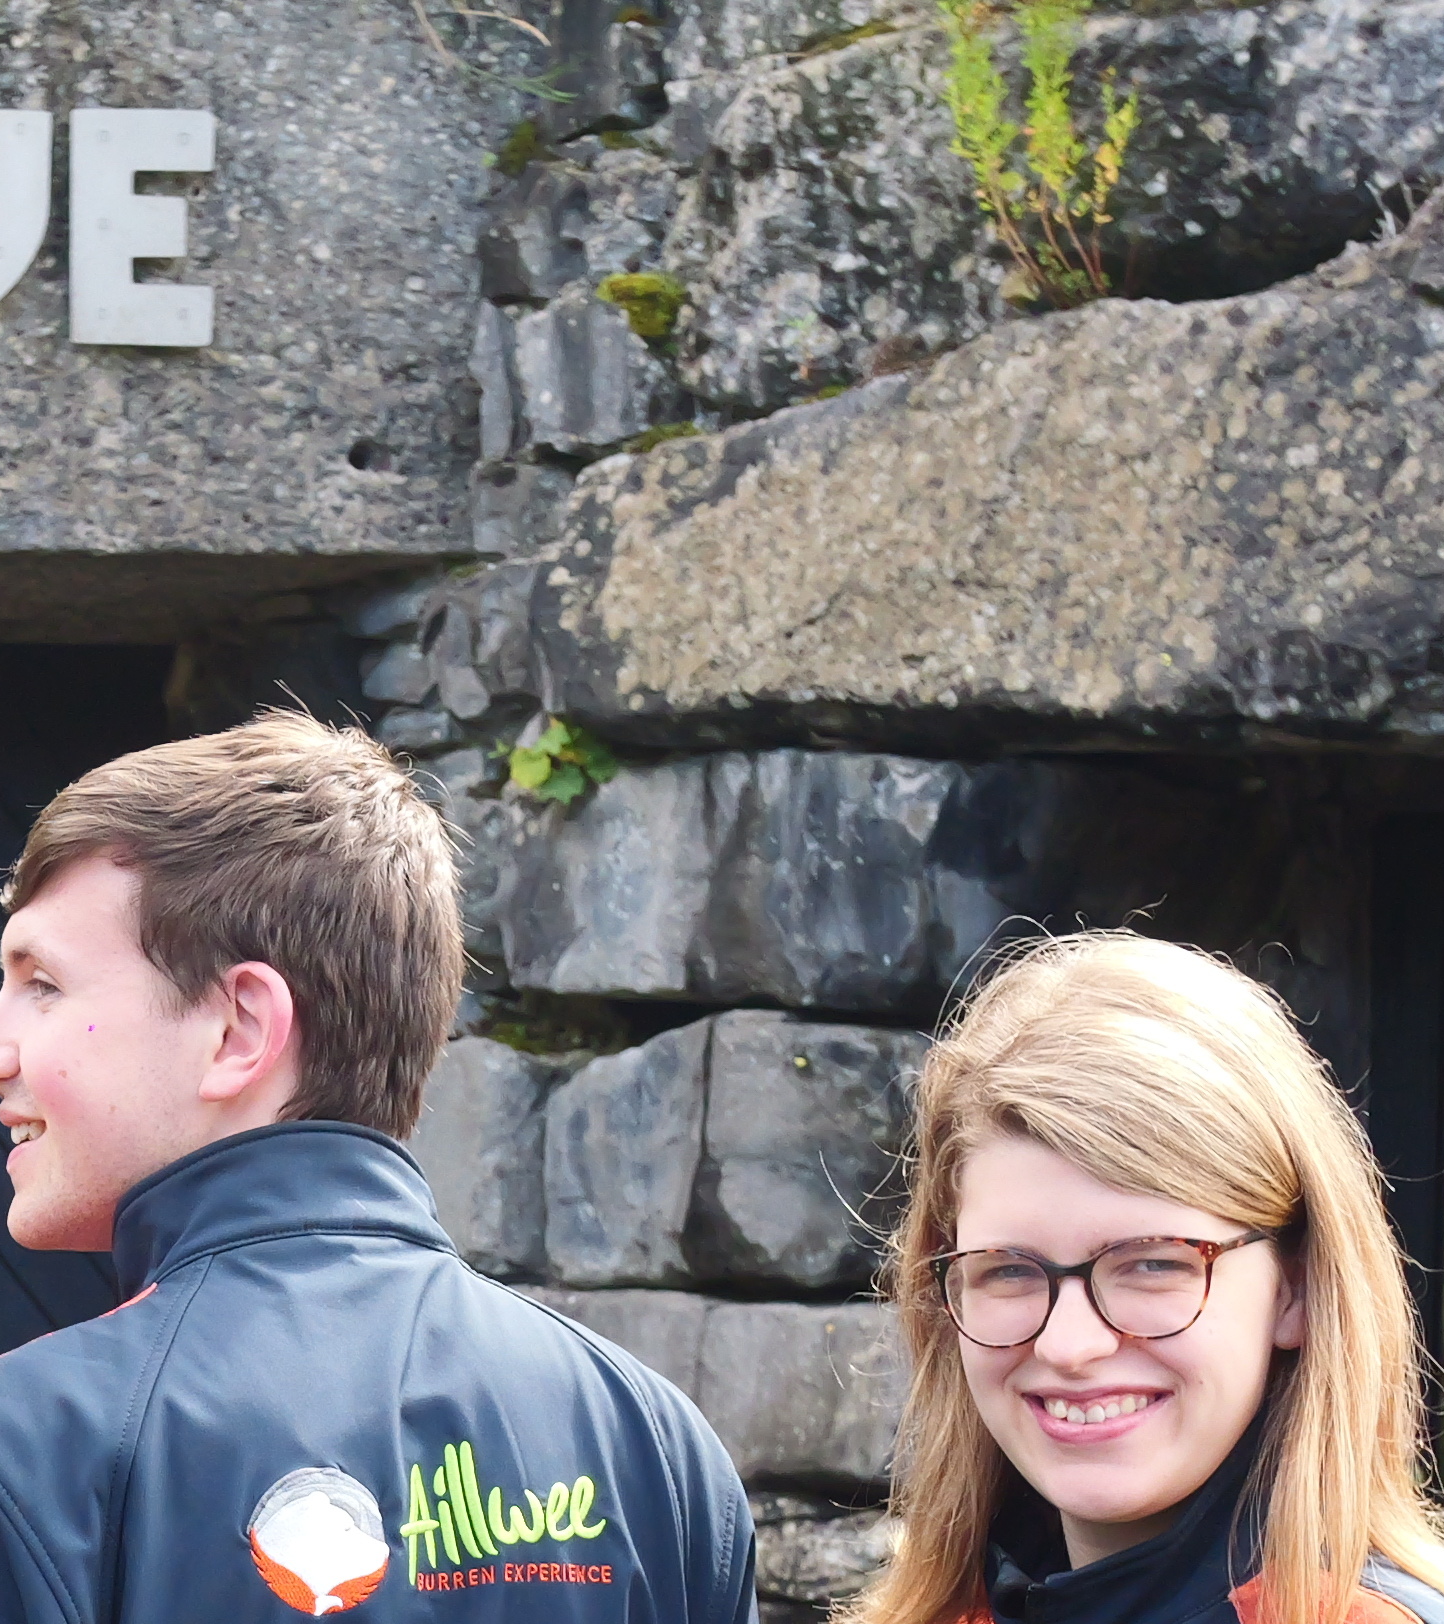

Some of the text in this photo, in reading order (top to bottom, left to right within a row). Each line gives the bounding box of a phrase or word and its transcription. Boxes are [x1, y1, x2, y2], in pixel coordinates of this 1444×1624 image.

[399, 1440, 606, 1586] Aillwee
[417, 1561, 612, 1592] BURREN EXPERIENCE
